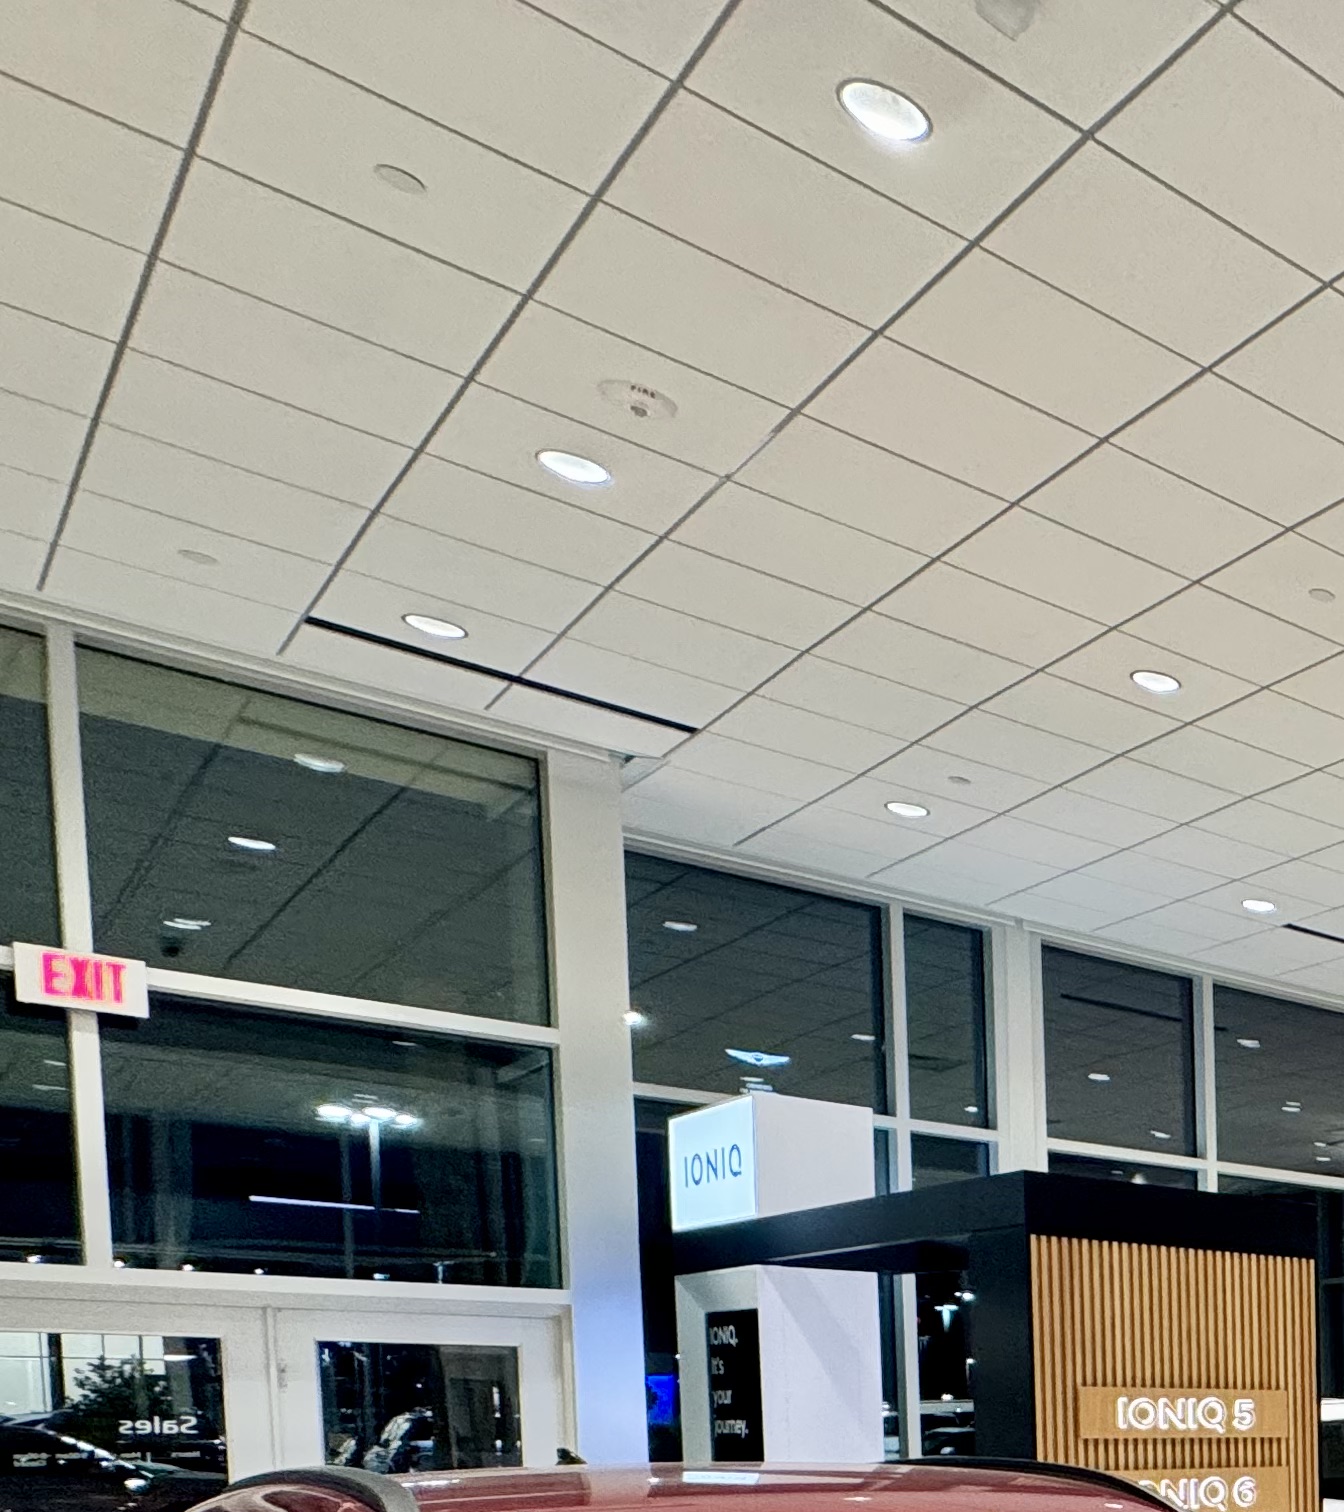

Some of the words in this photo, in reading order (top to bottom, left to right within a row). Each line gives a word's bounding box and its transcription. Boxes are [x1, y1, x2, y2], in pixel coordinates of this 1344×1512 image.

[42, 952, 127, 1004] EXIT
[684, 1143, 742, 1188] IONIQ
[712, 1389, 733, 1409] your
[1117, 1397, 1227, 1433] IONIQ
[1232, 1399, 1256, 1431] 5
[1232, 1476, 1258, 1508] 6
